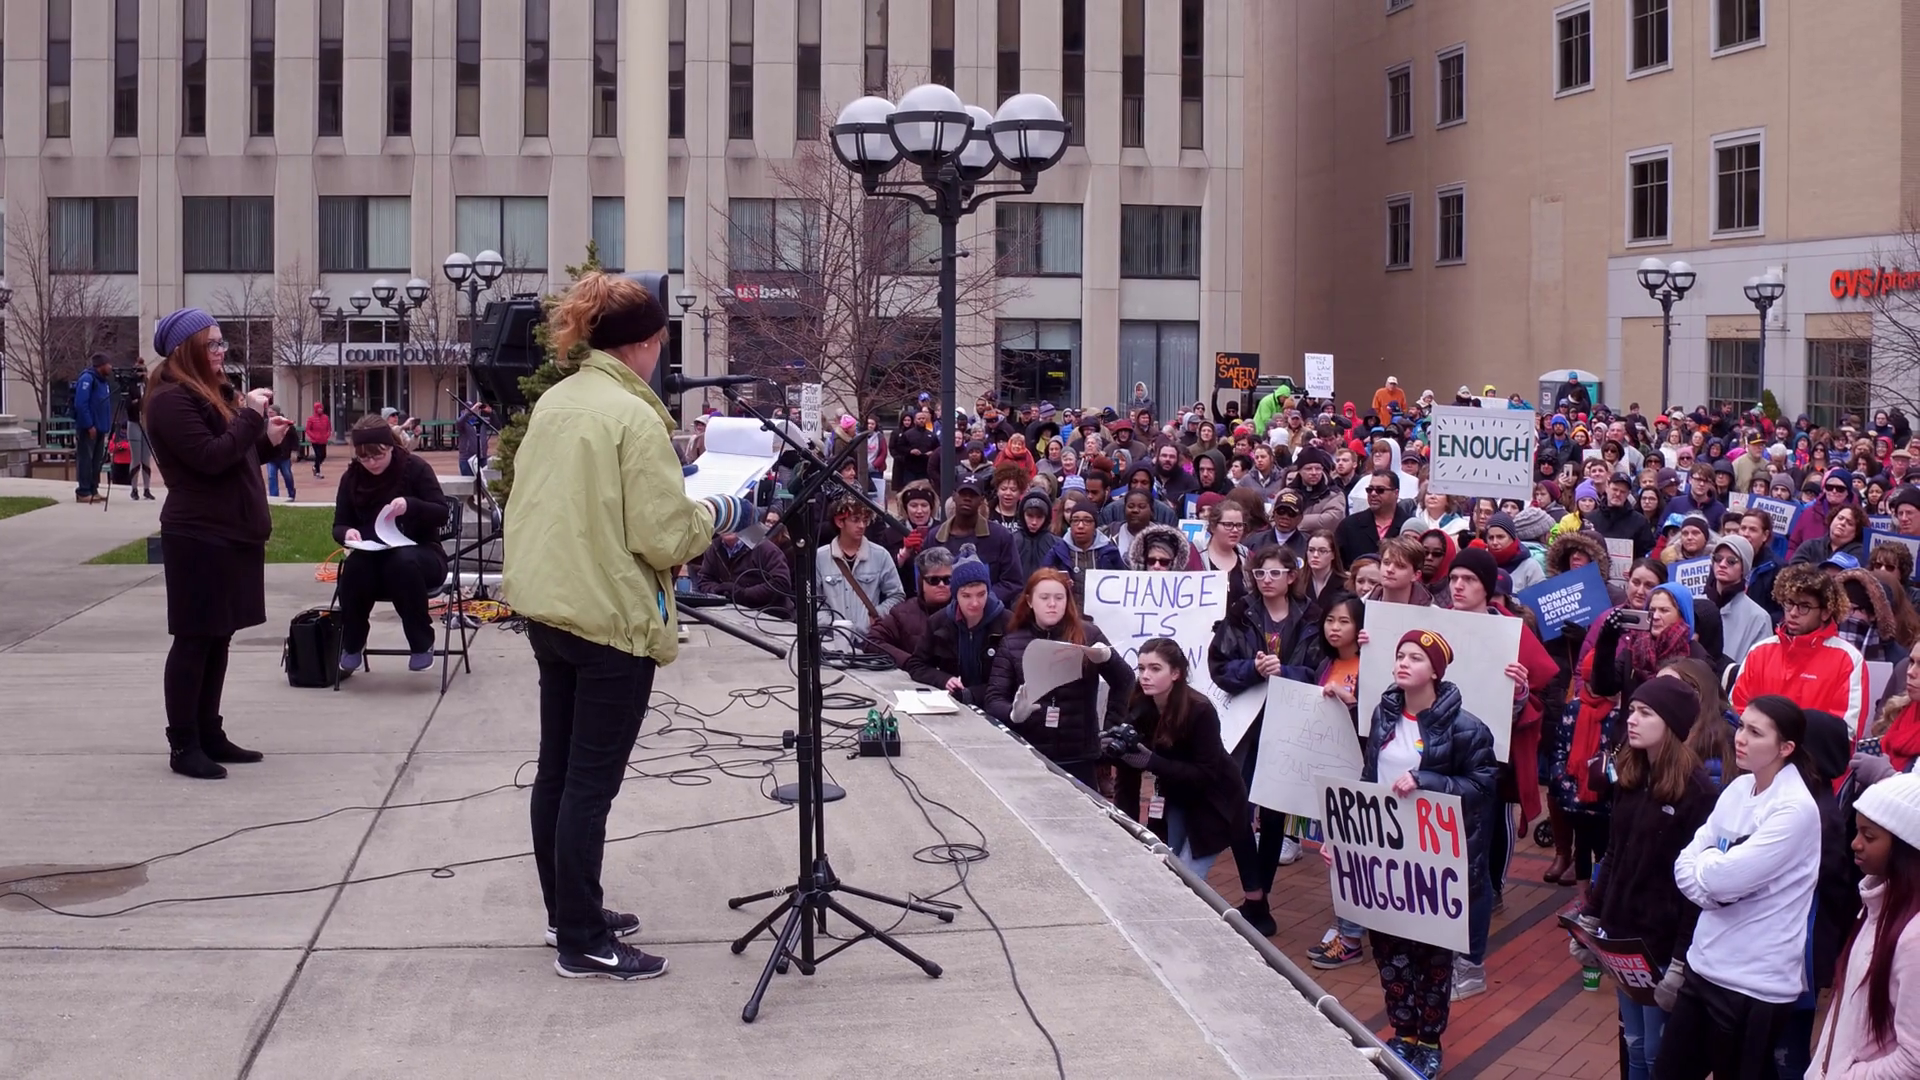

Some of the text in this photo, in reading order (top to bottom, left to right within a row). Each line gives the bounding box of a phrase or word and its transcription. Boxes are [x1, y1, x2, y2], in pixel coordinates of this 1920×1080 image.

[1829, 266, 1920, 298] CVS/phar
[445, 349, 469, 361] PLA
[1216, 353, 1240, 365] Gun
[1218, 365, 1257, 379] SAFETY
[802, 420, 818, 432] NOW
[1438, 434, 1529, 462] ENOUGH
[1757, 501, 1786, 515] MARCH
[1680, 564, 1711, 578] MARC
[1096, 574, 1218, 609] CHANGE
[1538, 588, 1568, 605] MOMS
[1541, 592, 1582, 613] DEMAND
[1544, 601, 1580, 621] ACTION
[1132, 613, 1178, 638] IS
[1281, 686, 1326, 716] NEVER
[1325, 786, 1404, 850] ARMS
[1333, 845, 1463, 919] HUGGING
[1609, 964, 1657, 988] TER
